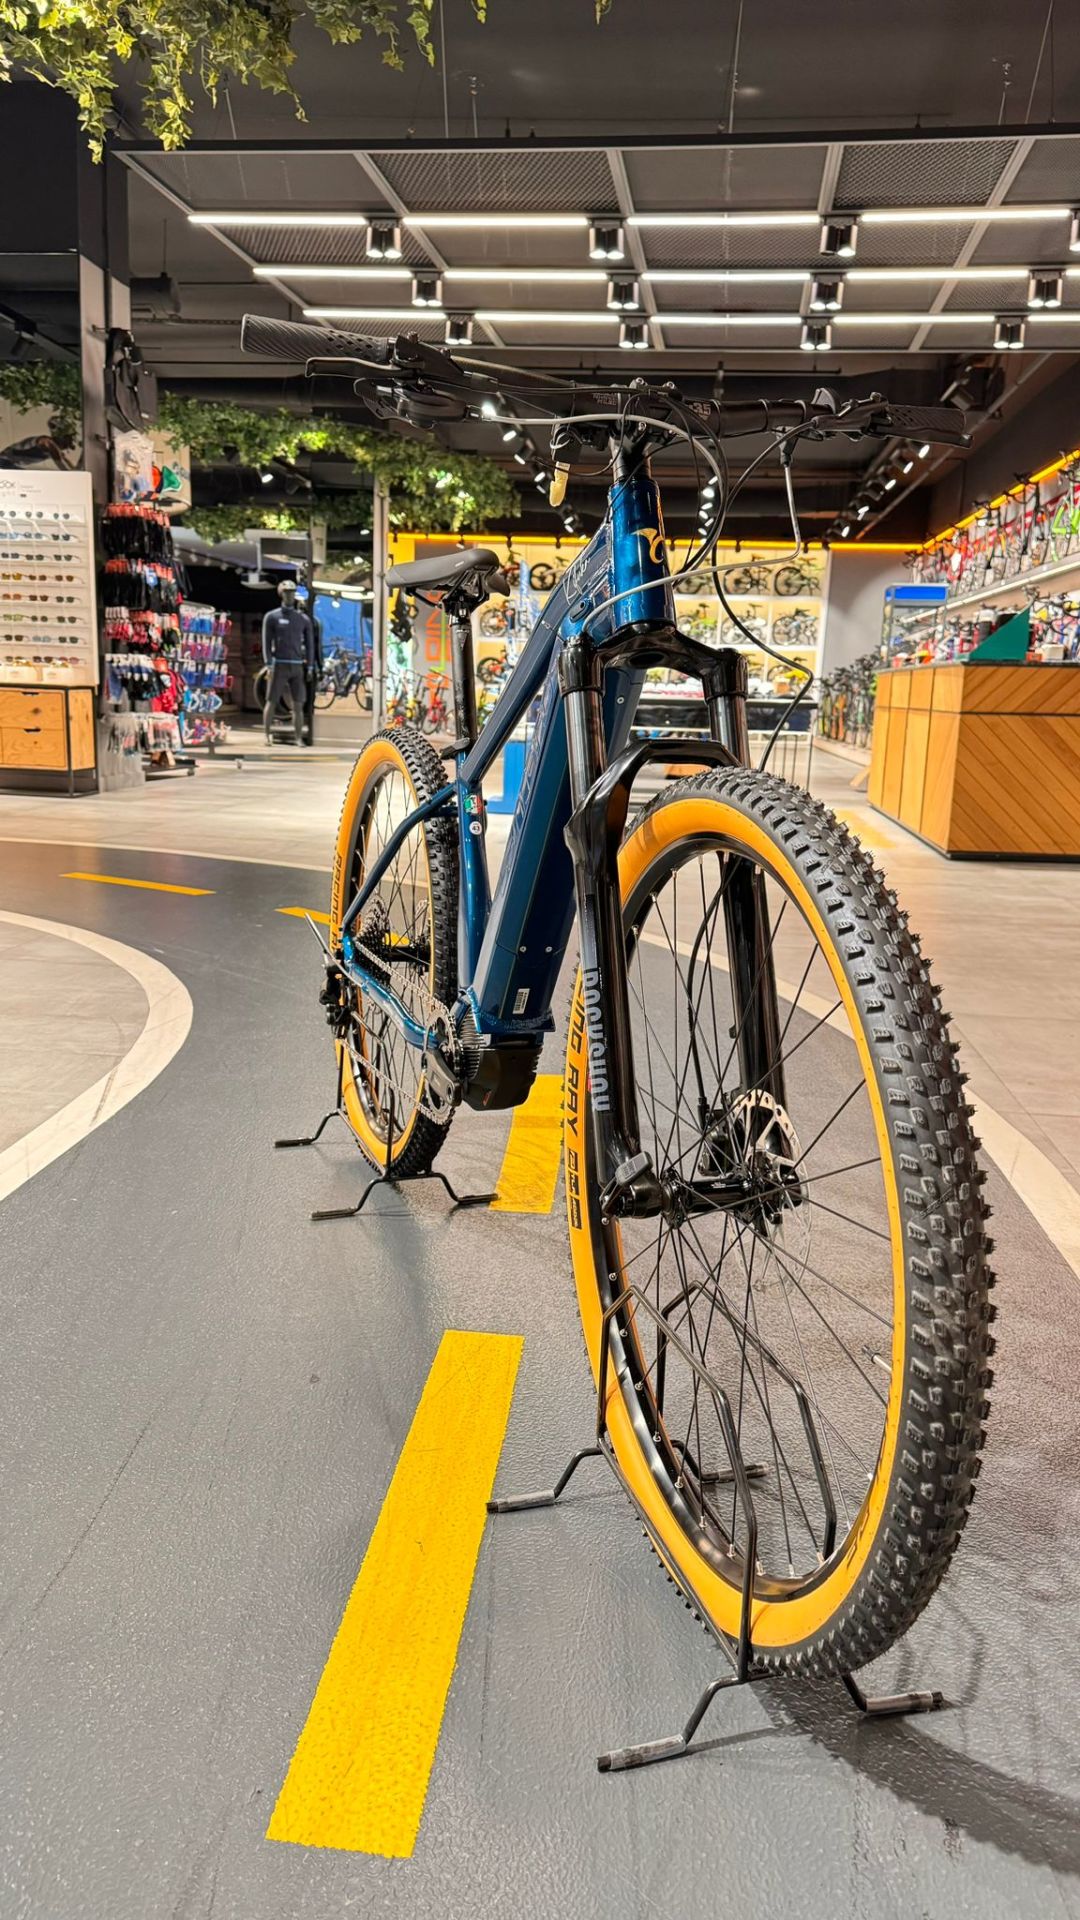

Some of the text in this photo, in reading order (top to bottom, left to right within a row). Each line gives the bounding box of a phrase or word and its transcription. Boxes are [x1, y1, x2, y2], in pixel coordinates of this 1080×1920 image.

[332, 852, 343, 924] RACING
[570, 980, 586, 1054] ING
[568, 1062, 580, 1138] RAY
